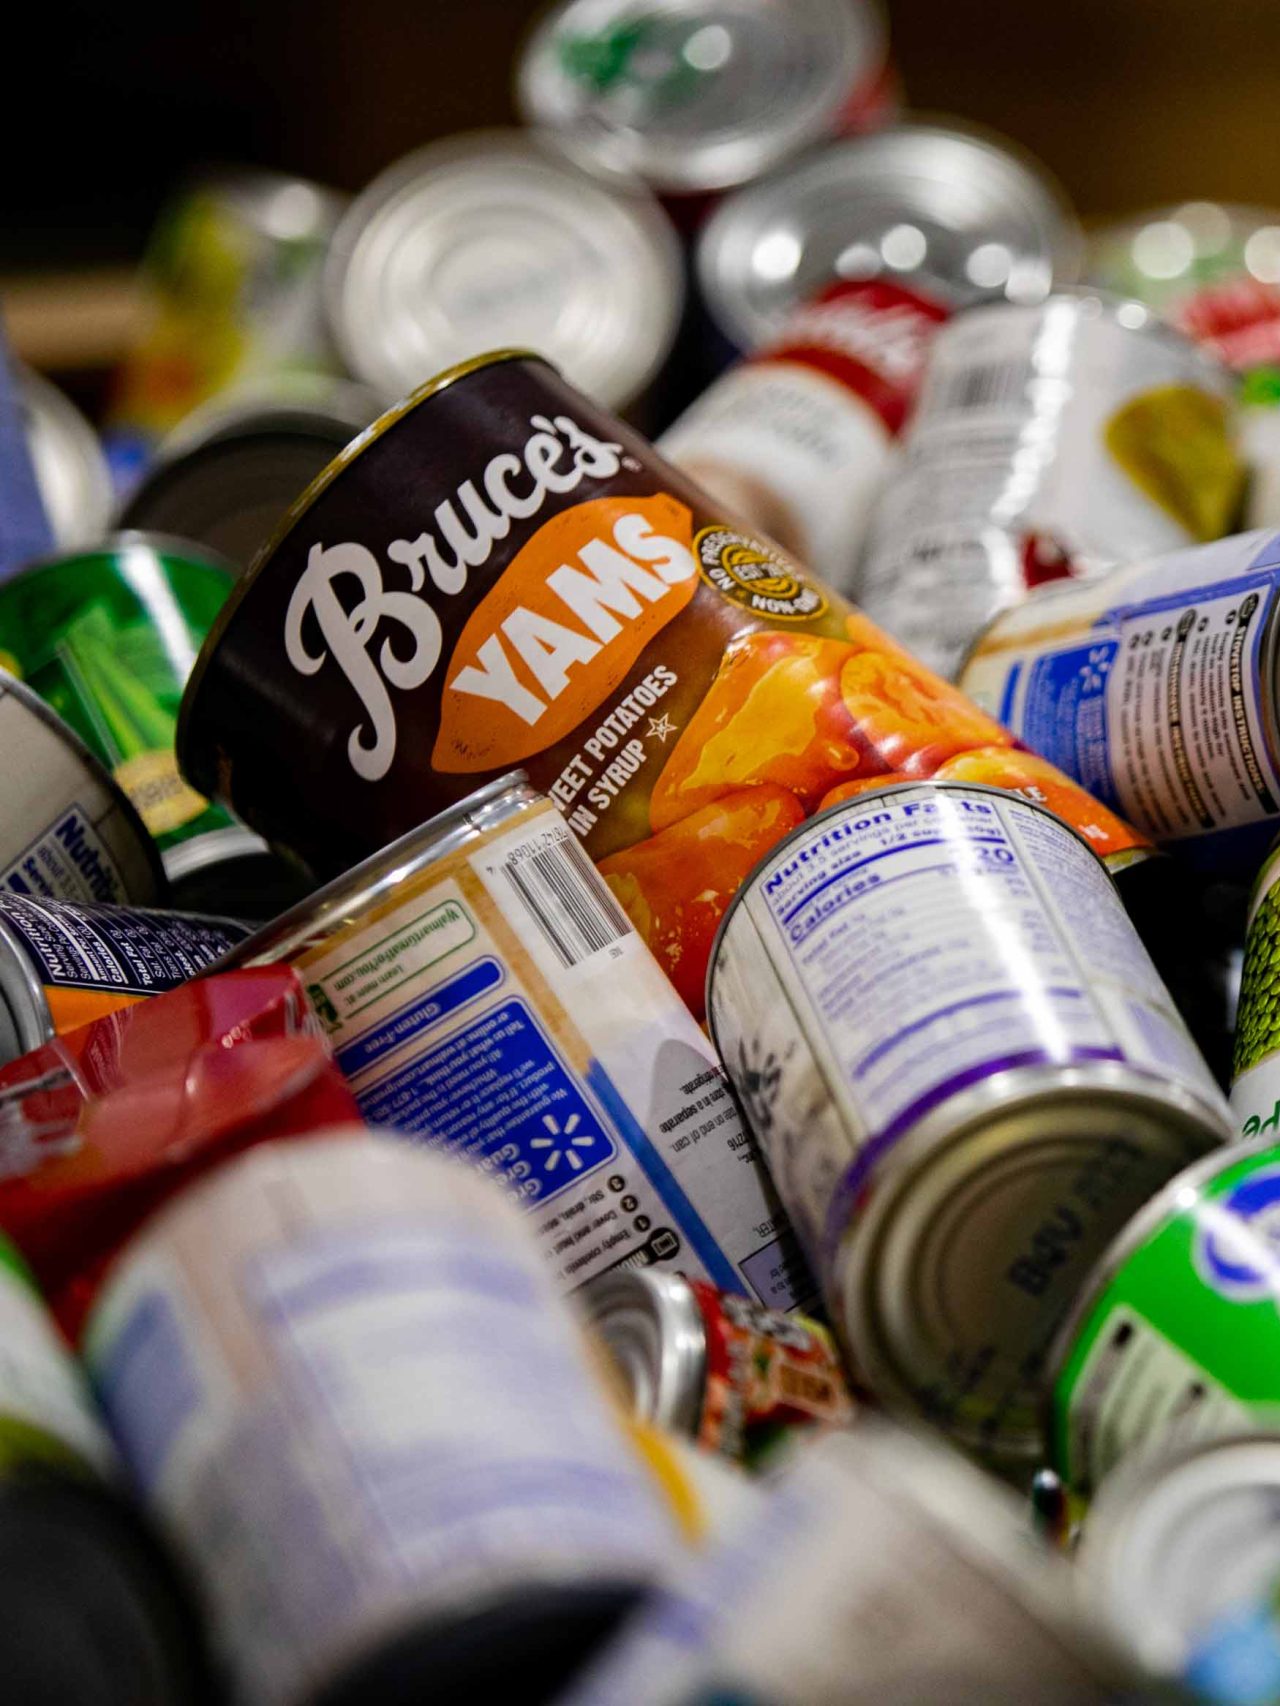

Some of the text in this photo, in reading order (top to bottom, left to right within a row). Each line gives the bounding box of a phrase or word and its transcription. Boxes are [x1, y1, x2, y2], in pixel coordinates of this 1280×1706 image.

[285, 414, 626, 780] Bruce's
[449, 513, 697, 726] YAMS
[1231, 626, 1248, 692] STOVETOP
[543, 656, 679, 811] EET POTATOES
[566, 735, 652, 837] IN SYRUP
[765, 812, 892, 896] Nutrition
[902, 800, 993, 816] Fats
[788, 873, 882, 943] Calories
[973, 846, 1015, 864] 20
[11, 911, 66, 977] Nutrition
[92, 941, 123, 983] Calories
[120, 942, 153, 986] Total Fat
[174, 951, 196, 976] olest.
[362, 999, 443, 1058] Gluten-Free
[465, 1035, 495, 1059] what
[502, 1016, 524, 1036] Tell
[446, 1050, 468, 1069] you
[446, 1066, 498, 1104] Whichever
[656, 1100, 700, 1137] separate
[697, 1118, 718, 1138] end
[493, 1156, 533, 1192] Gre
[506, 1173, 545, 1208] Gre
